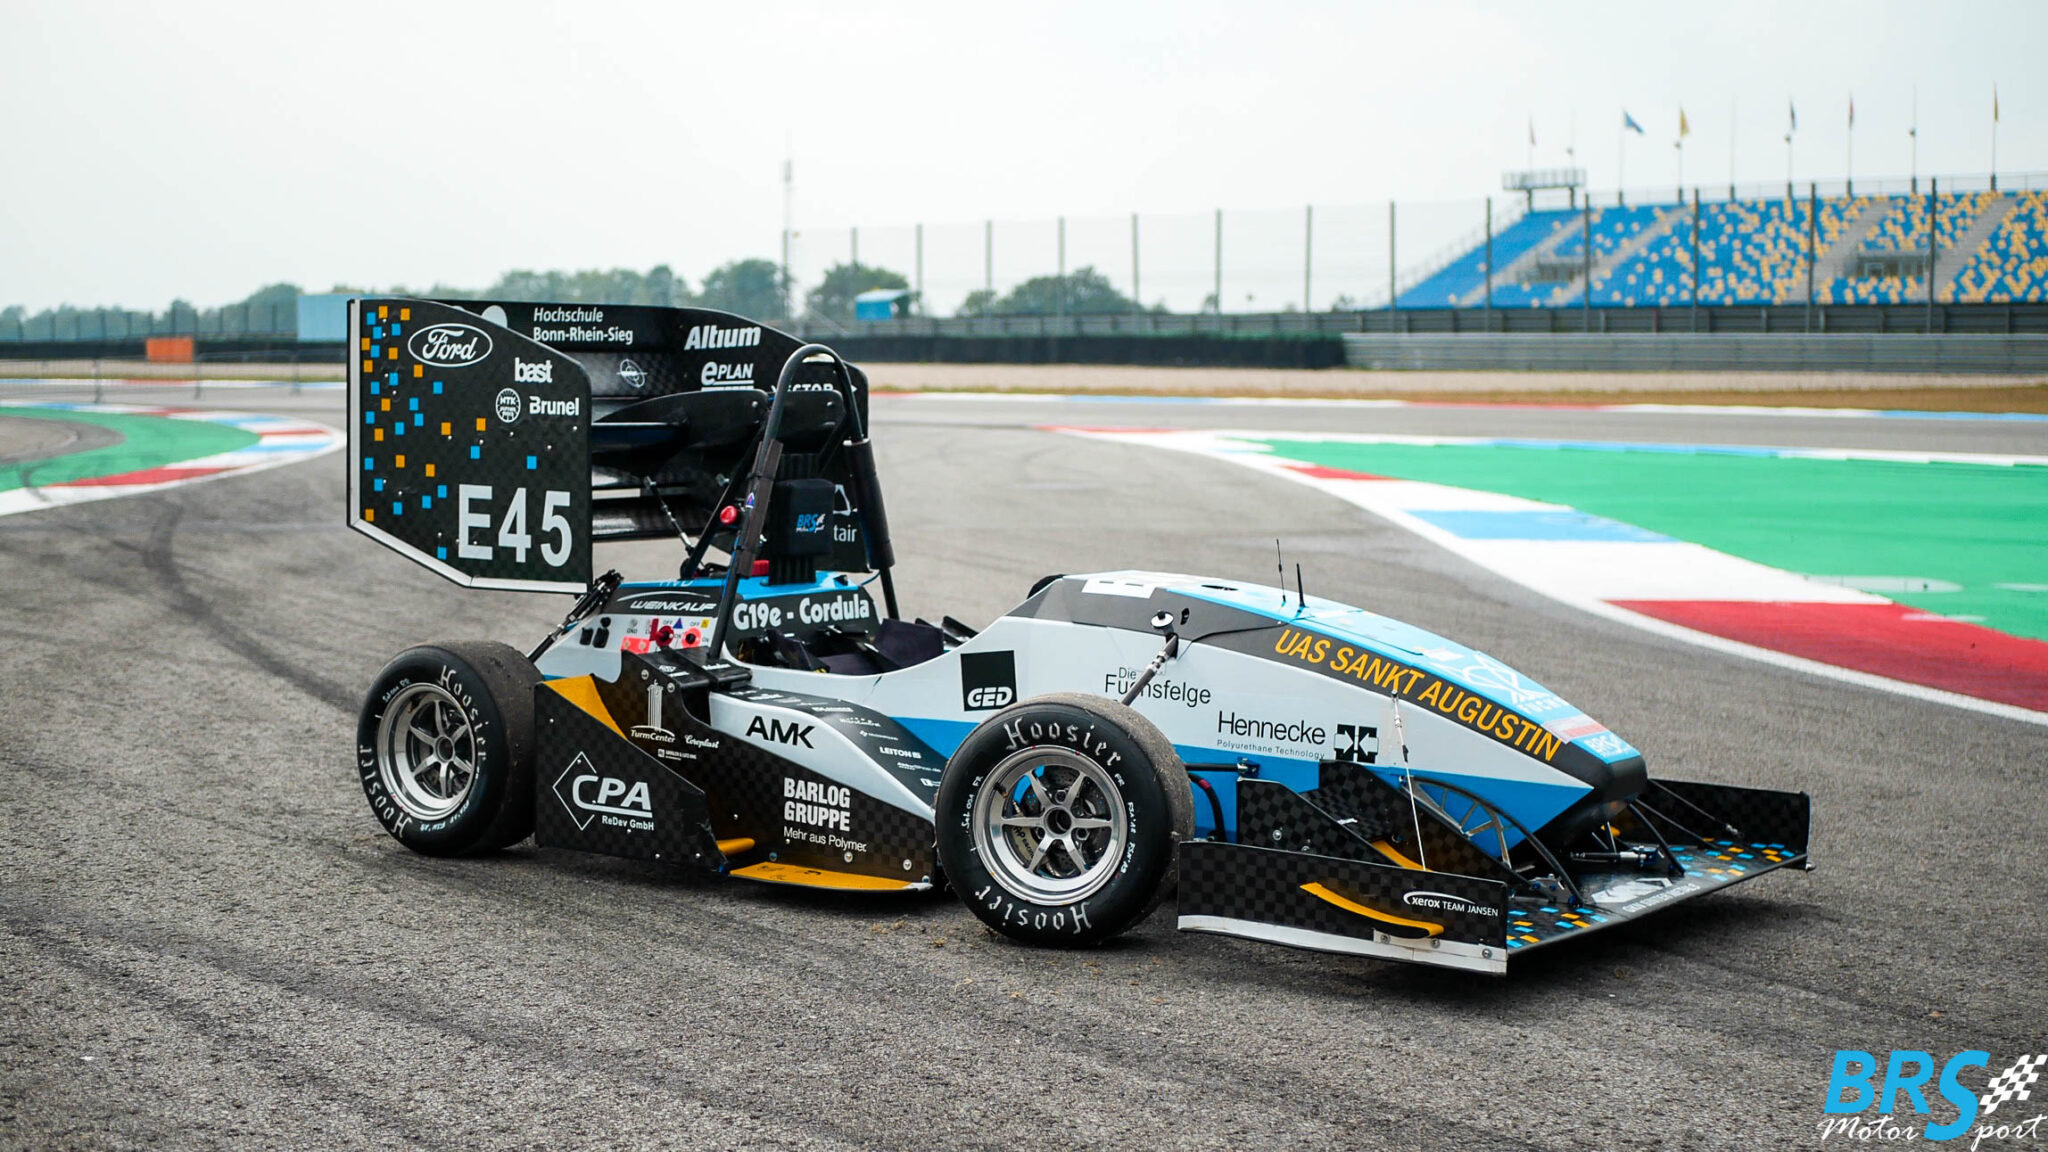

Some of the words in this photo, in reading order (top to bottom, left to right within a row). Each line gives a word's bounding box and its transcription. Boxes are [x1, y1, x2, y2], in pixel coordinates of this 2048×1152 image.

[533, 306, 604, 323] Hochschule
[422, 328, 478, 360] Ford
[533, 325, 634, 345] Bonn-Rhein-Sieg
[683, 325, 762, 350] Altium
[514, 357, 553, 383] bast
[529, 396, 580, 416] Brunel
[458, 483, 573, 567] E45
[630, 600, 717, 611] WEINKAUF
[732, 602, 782, 630] G19e
[799, 593, 870, 624] Cordula
[1118, 667, 1137, 680] Die
[967, 686, 1013, 707] GED
[1105, 673, 1211, 708] Fuhsfelge
[1274, 629, 1332, 664] UAS
[1330, 646, 1426, 696] SANKT
[1418, 680, 1563, 763] AUGUSTIN
[438, 665, 489, 761] Hoosier
[630, 729, 676, 743] TurmCenter
[745, 715, 815, 749] AMK
[1003, 716, 1122, 766] Hoosier
[1218, 710, 1326, 745] Hennecke
[1217, 739, 1273, 753] Polyurethane
[1275, 746, 1326, 760] Technology
[572, 774, 653, 815] CPA
[783, 777, 851, 808] BARLOG
[601, 815, 628, 827] ReDev
[629, 819, 655, 831] GmbH
[784, 800, 851, 832] GRUPPE
[783, 825, 808, 840] Mehr
[808, 833, 827, 844] aus
[974, 885, 1093, 934] Hoosier
[1411, 896, 1440, 909] xerox
[1442, 900, 1465, 912] TEAM
[1467, 904, 1499, 917] JANSEN
